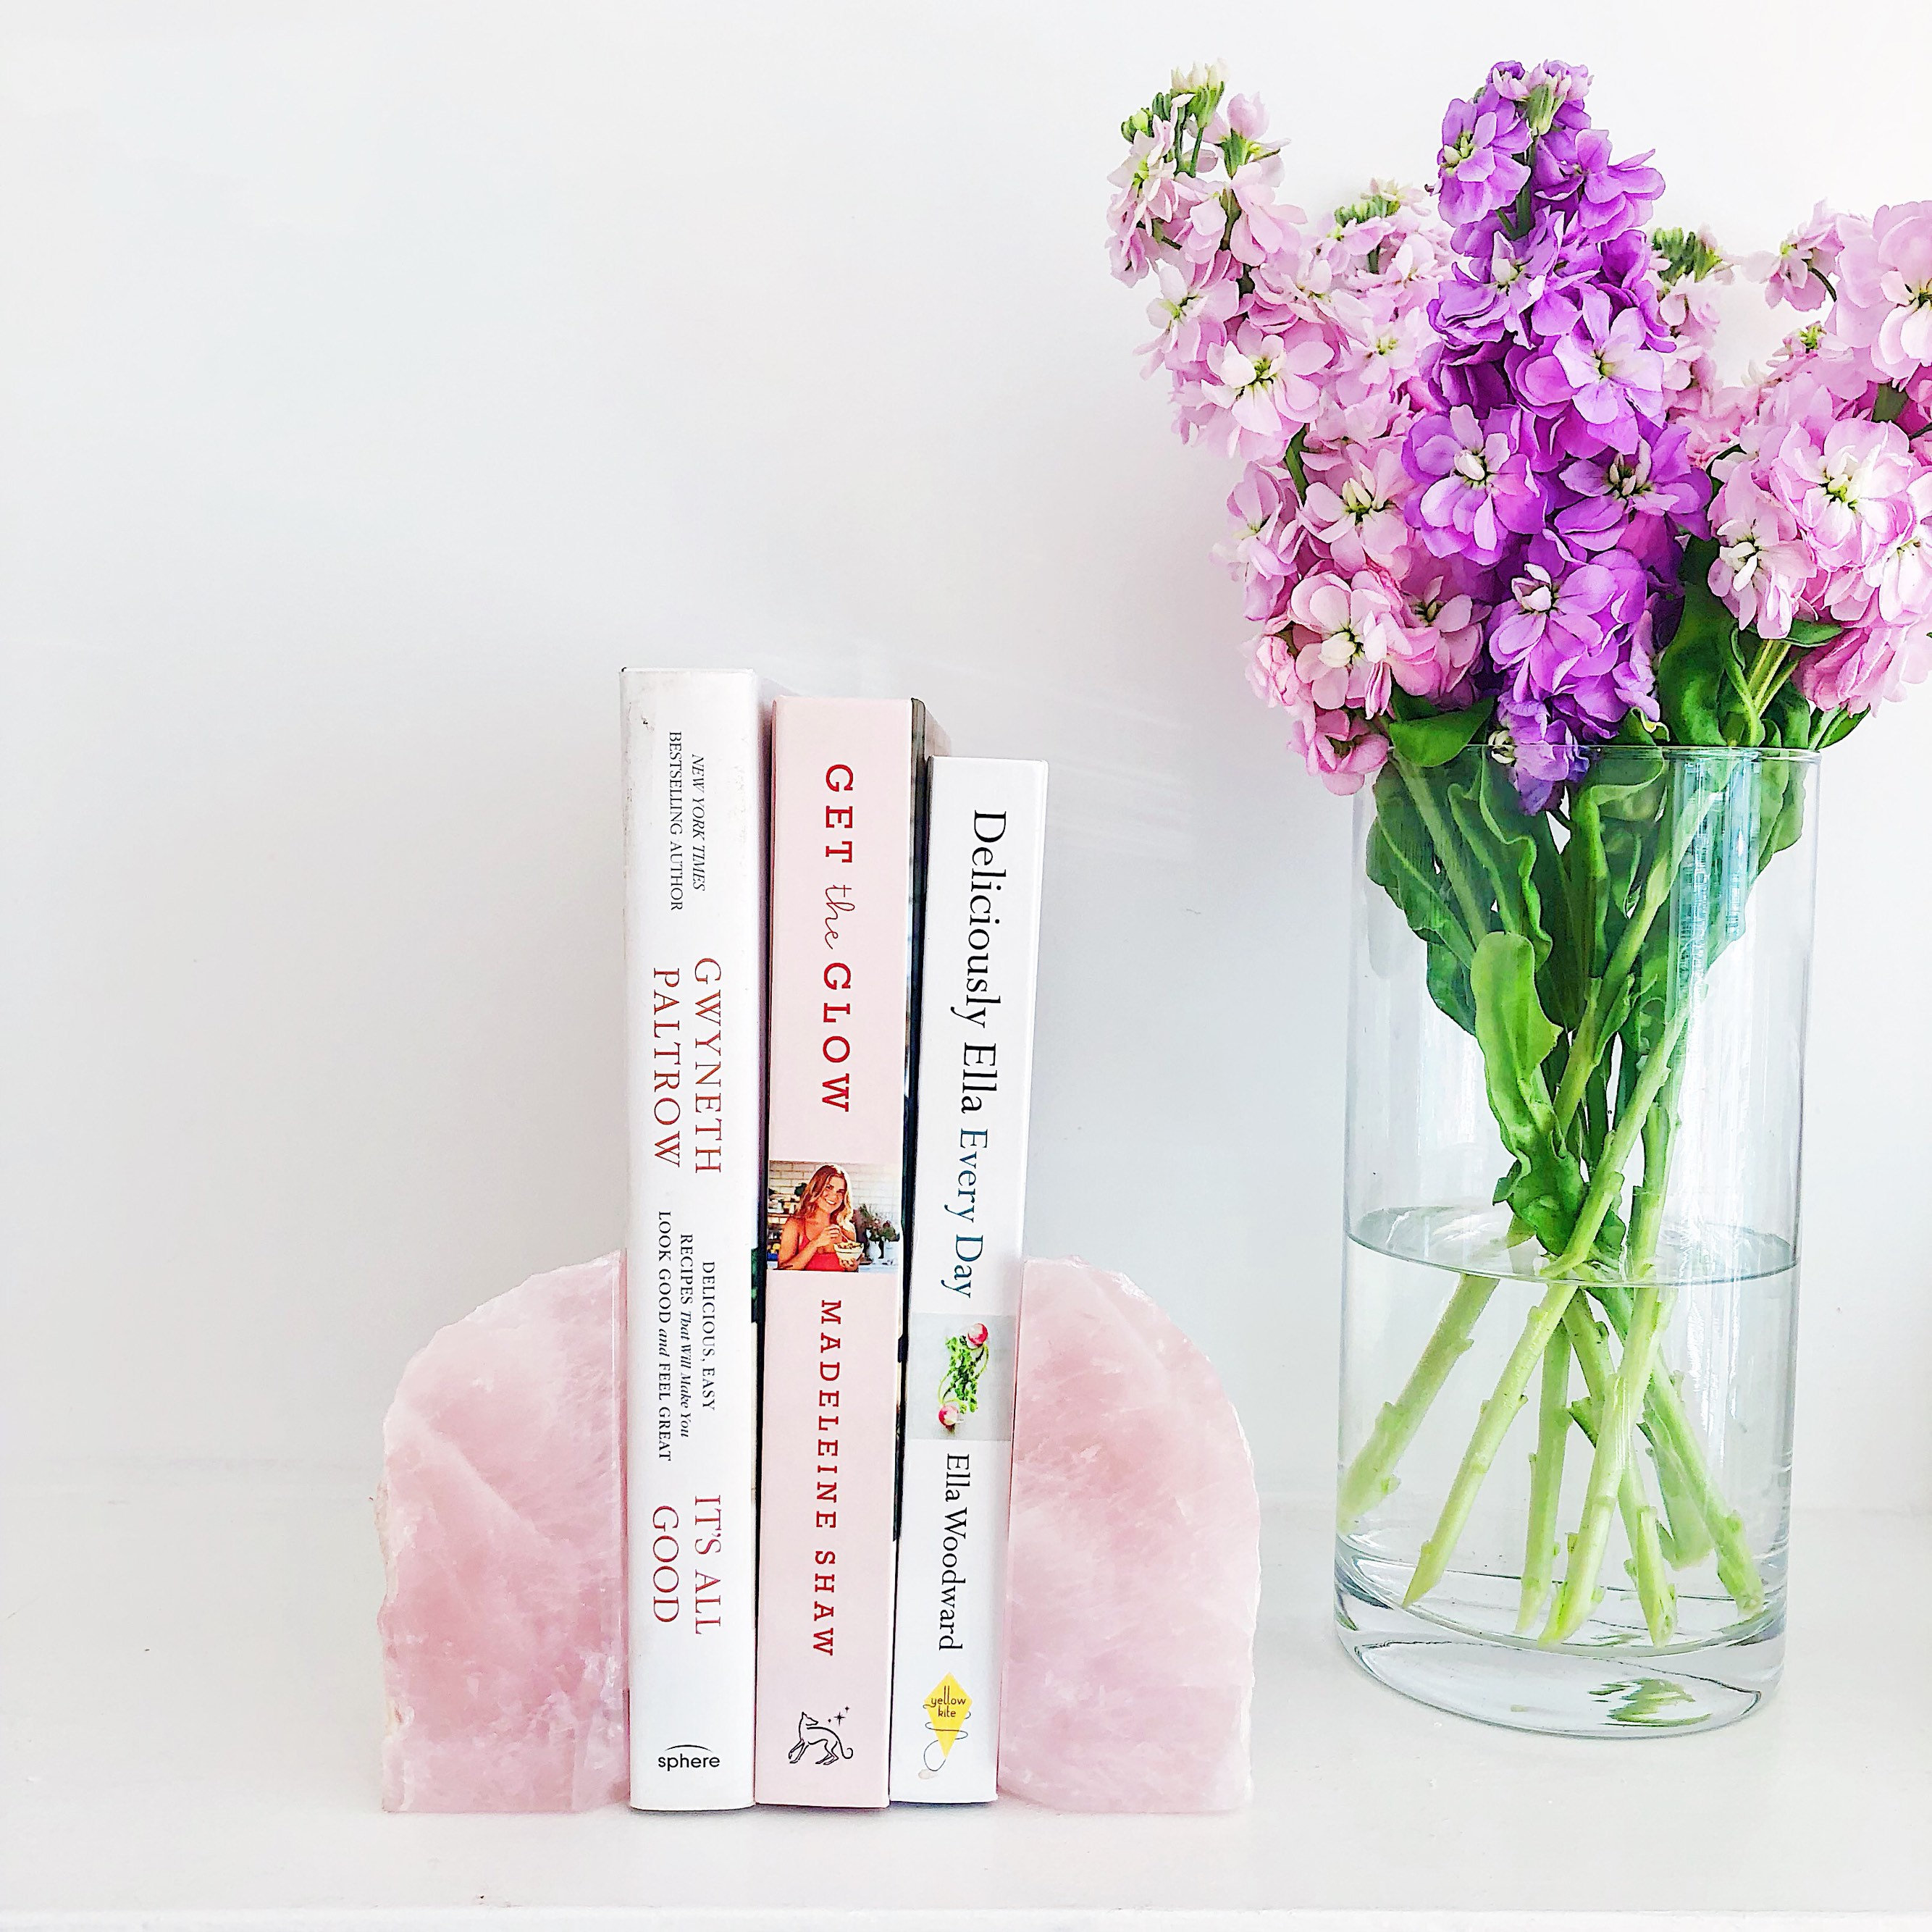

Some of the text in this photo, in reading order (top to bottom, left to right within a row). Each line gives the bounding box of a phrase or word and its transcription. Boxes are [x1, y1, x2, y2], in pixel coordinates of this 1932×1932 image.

[668, 731, 684, 911] BESTSELLING AUTHOR
[691, 753, 706, 892] NEW YORK TIMES
[821, 763, 856, 1113] GET the GLOW
[653, 967, 681, 1168] PALTROW
[694, 957, 723, 1174] GWYNETH
[940, 809, 1007, 1299] Deliciously Ella Every Day
[658, 1210, 672, 1462] LOOK GOOD and FEEL GREAT
[680, 1233, 694, 1437] RECIPES That Will Make You
[700, 1261, 715, 1411] DELICIOUS, EASY
[652, 1505, 680, 1623] GOOD
[812, 1299, 842, 1657] MADELEINE SHAW
[938, 1453, 971, 1651] Ella Woodward
[694, 1568, 721, 1635] ALL
[658, 1752, 721, 1772] sphere
[927, 1685, 967, 1708] yellow
[938, 1705, 957, 1718] kite
